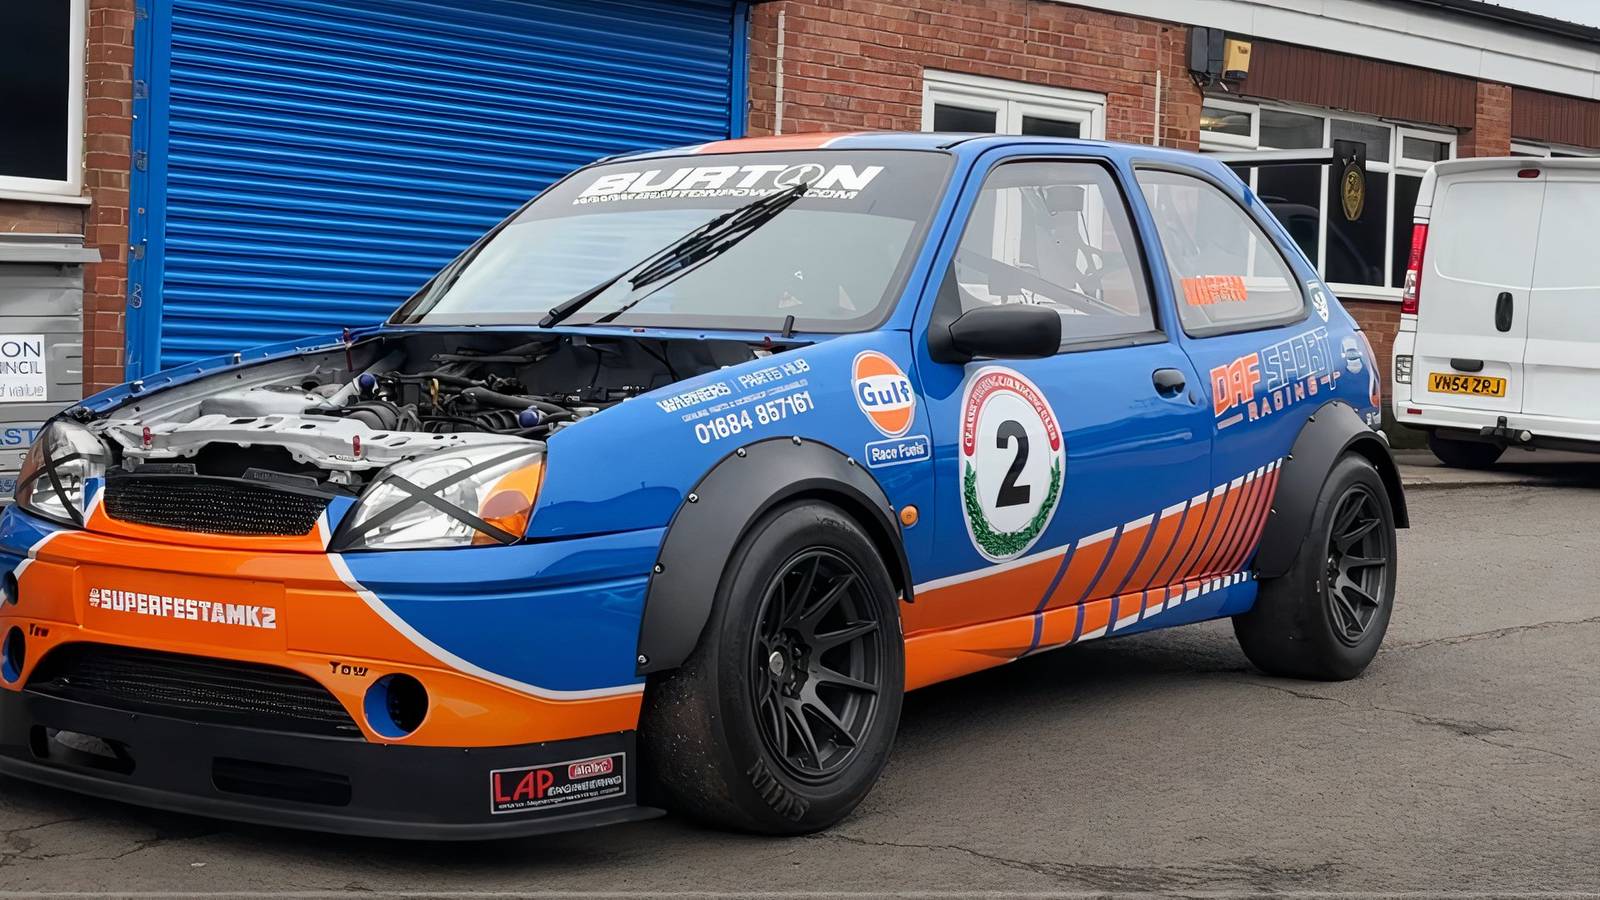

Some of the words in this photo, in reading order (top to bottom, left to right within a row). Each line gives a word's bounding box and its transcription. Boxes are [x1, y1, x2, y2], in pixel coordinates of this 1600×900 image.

[578, 163, 885, 197] BURTON
[0, 360, 43, 375] NCIL
[738, 366, 783, 389] PARTS
[781, 358, 810, 376] HUB
[1210, 352, 1261, 417] DAF
[1261, 325, 1337, 391] SPORT
[858, 380, 910, 406] Gulf
[1248, 375, 1318, 422] RACING
[1434, 375, 1469, 392] VN54
[1472, 378, 1501, 394] ZRJ
[694, 410, 753, 444] 01684
[872, 447, 898, 462] Race
[898, 442, 925, 458] Fuels
[995, 419, 1031, 508] 2
[494, 769, 554, 802] LAP
